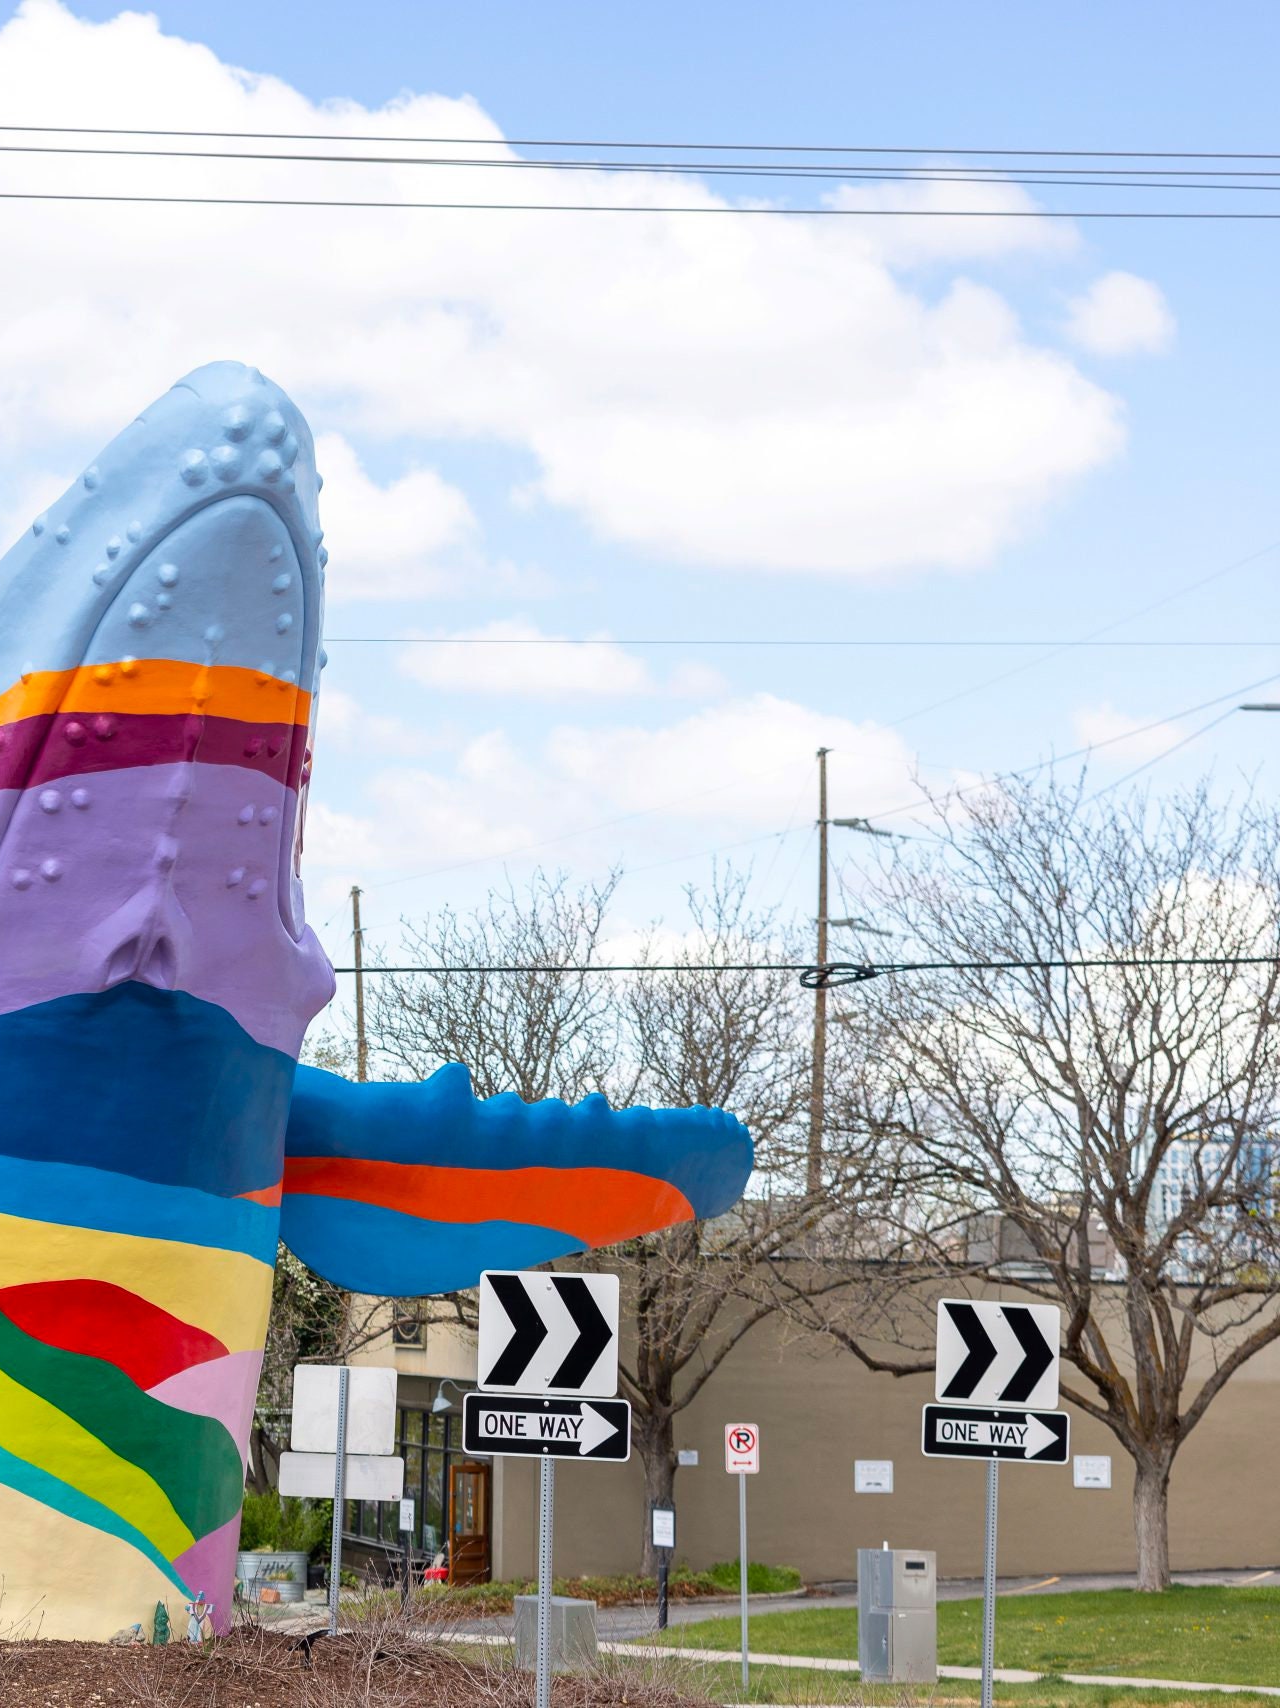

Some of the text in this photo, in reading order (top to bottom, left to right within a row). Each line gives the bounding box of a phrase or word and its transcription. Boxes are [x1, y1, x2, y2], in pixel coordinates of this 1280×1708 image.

[484, 1413, 584, 1439] ONE WAY
[941, 1421, 1028, 1445] ONE WAY
